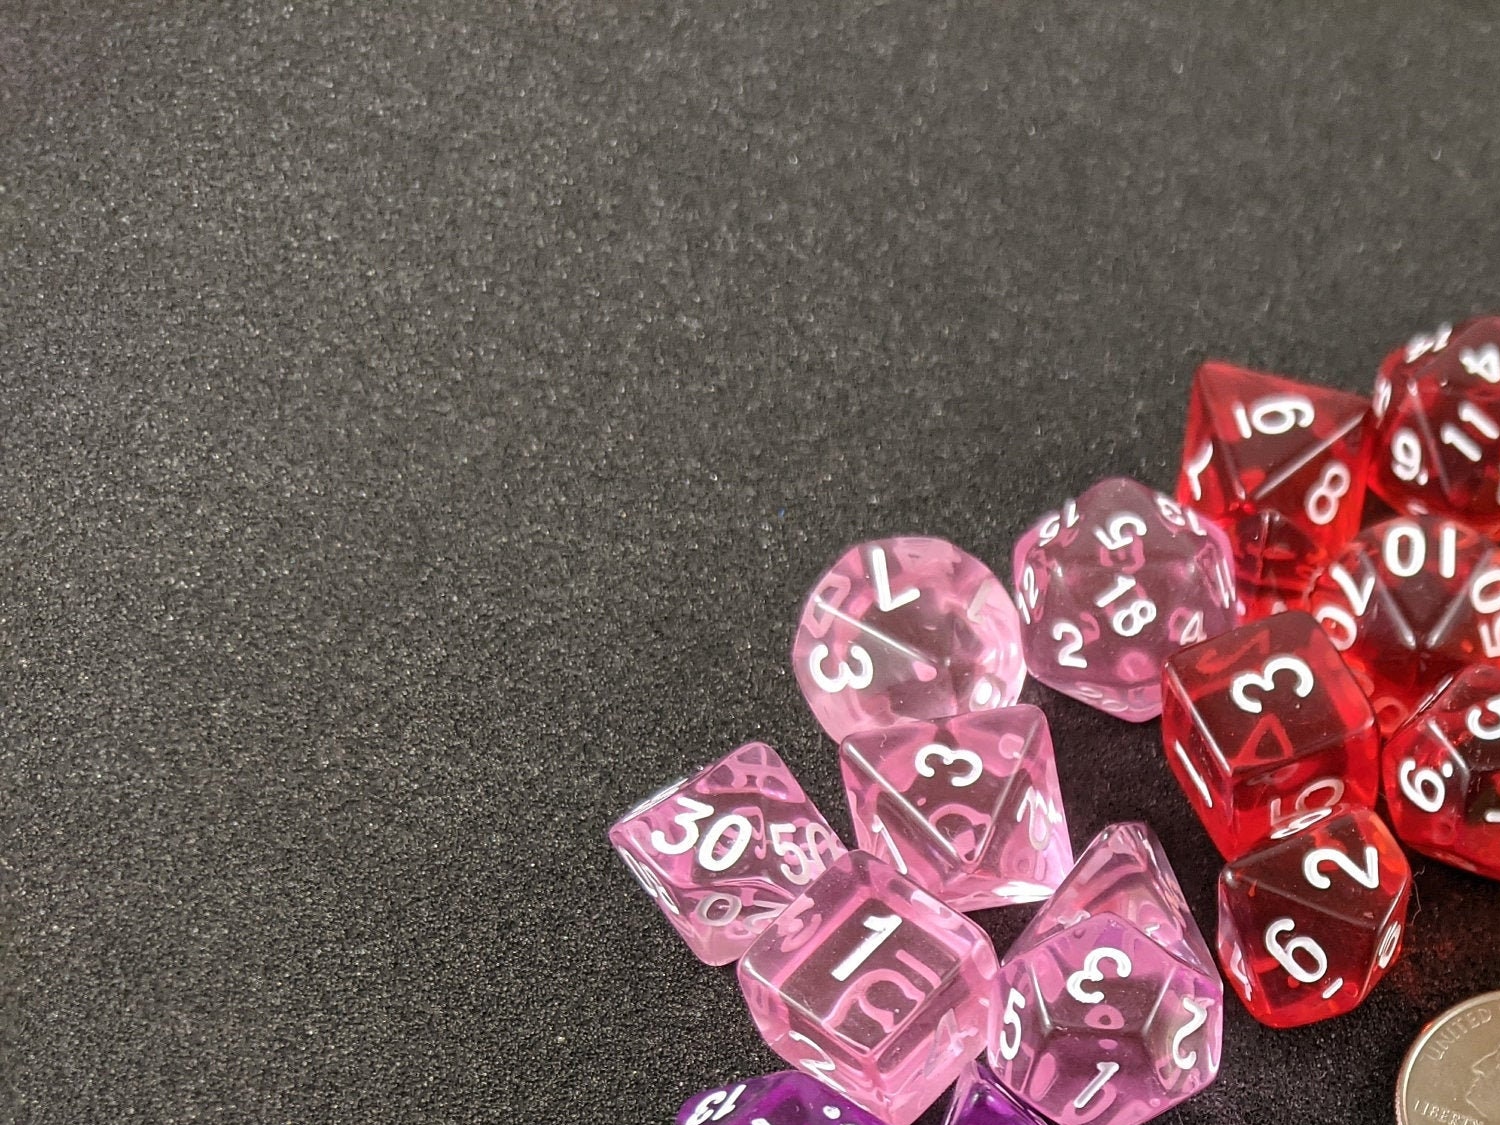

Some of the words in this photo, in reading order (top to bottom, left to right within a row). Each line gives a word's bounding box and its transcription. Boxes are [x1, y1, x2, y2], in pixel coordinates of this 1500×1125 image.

[1441, 401, 1500, 463] 11
[1304, 462, 1351, 526] 8
[1095, 515, 1147, 550] 5
[1096, 577, 1156, 635] 18
[809, 644, 873, 693] 3
[1053, 623, 1087, 667] 2
[1230, 655, 1315, 714] 3
[915, 745, 983, 788] 3
[651, 797, 752, 871] 30
[1304, 847, 1379, 889] 2
[831, 914, 903, 982] 1
[1066, 948, 1132, 1004] 3
[999, 988, 1026, 1061] 5
[1424, 1007, 1493, 1062] UNITED
[1074, 1062, 1120, 1108] 1
